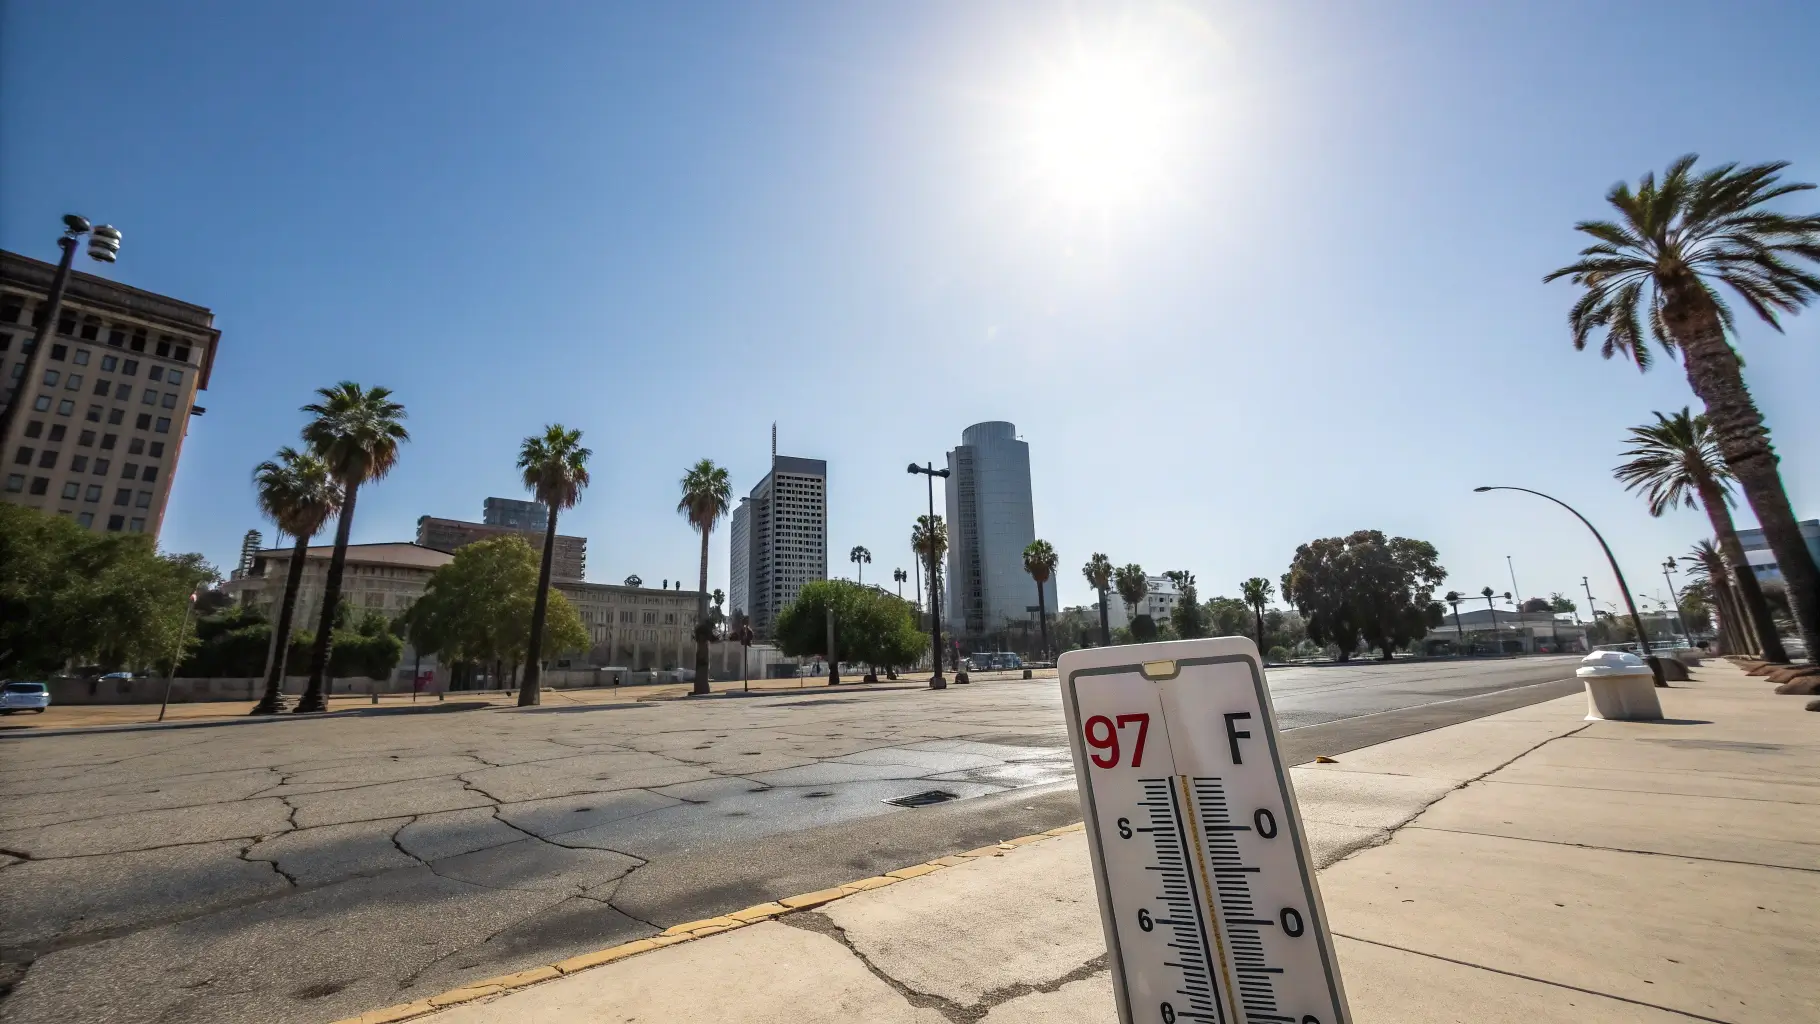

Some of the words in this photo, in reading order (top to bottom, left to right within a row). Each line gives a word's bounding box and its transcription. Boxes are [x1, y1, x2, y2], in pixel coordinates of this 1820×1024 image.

[1085, 714, 1149, 768] 97
[1223, 712, 1251, 765] F
[1138, 908, 1153, 932] 6
